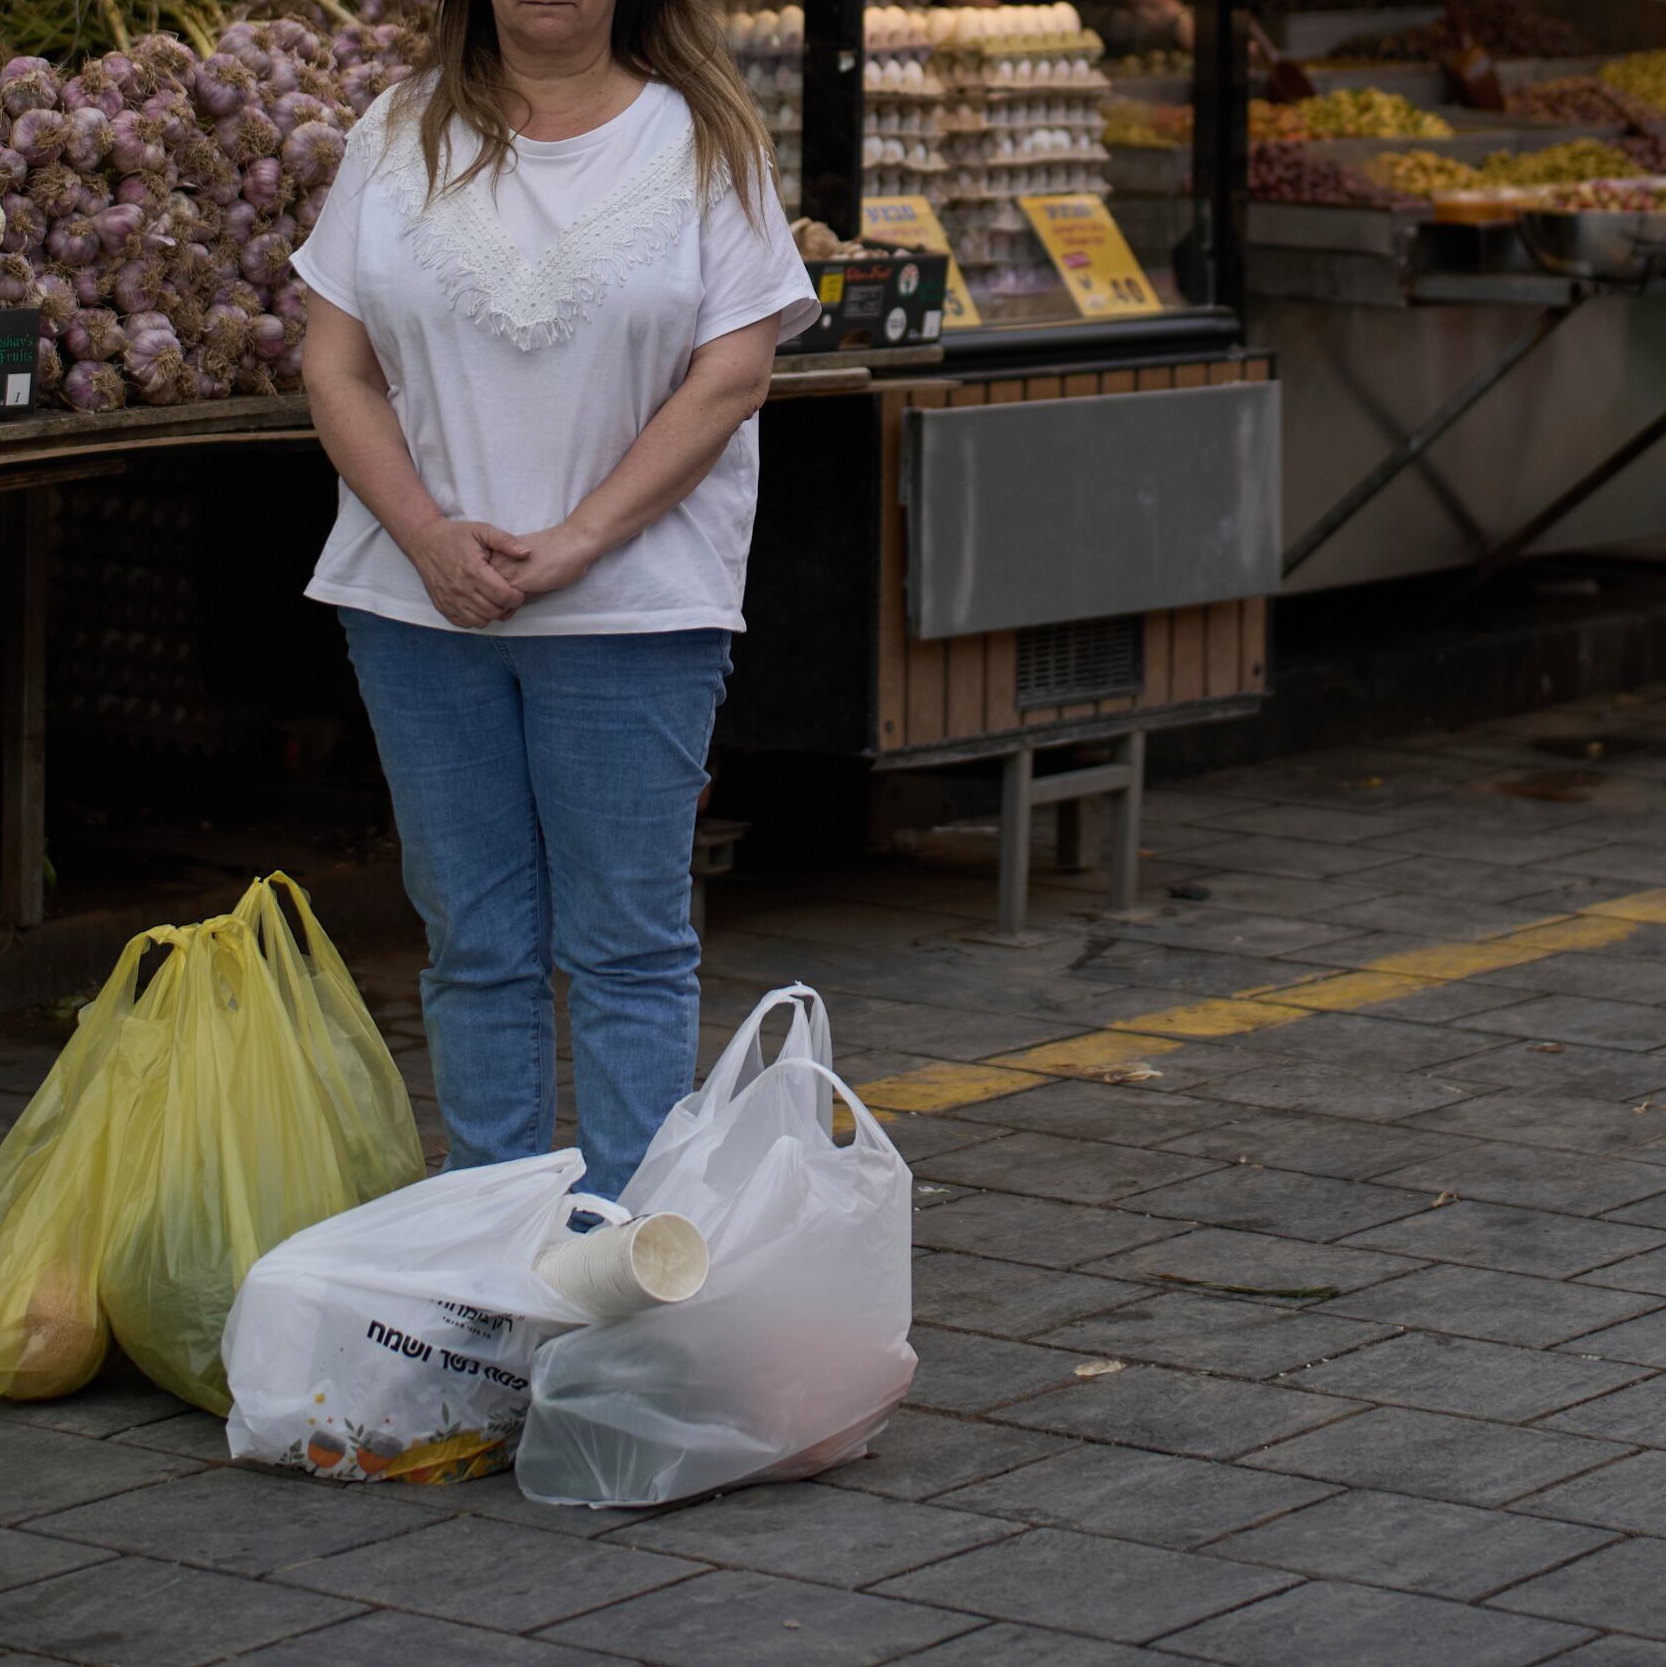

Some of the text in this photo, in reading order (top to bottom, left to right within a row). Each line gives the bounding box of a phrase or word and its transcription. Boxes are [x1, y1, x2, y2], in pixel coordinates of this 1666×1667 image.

[366, 1318, 434, 1363] ושמח
[439, 1347, 482, 1376] כשר
[483, 1364, 531, 1393] פסח
